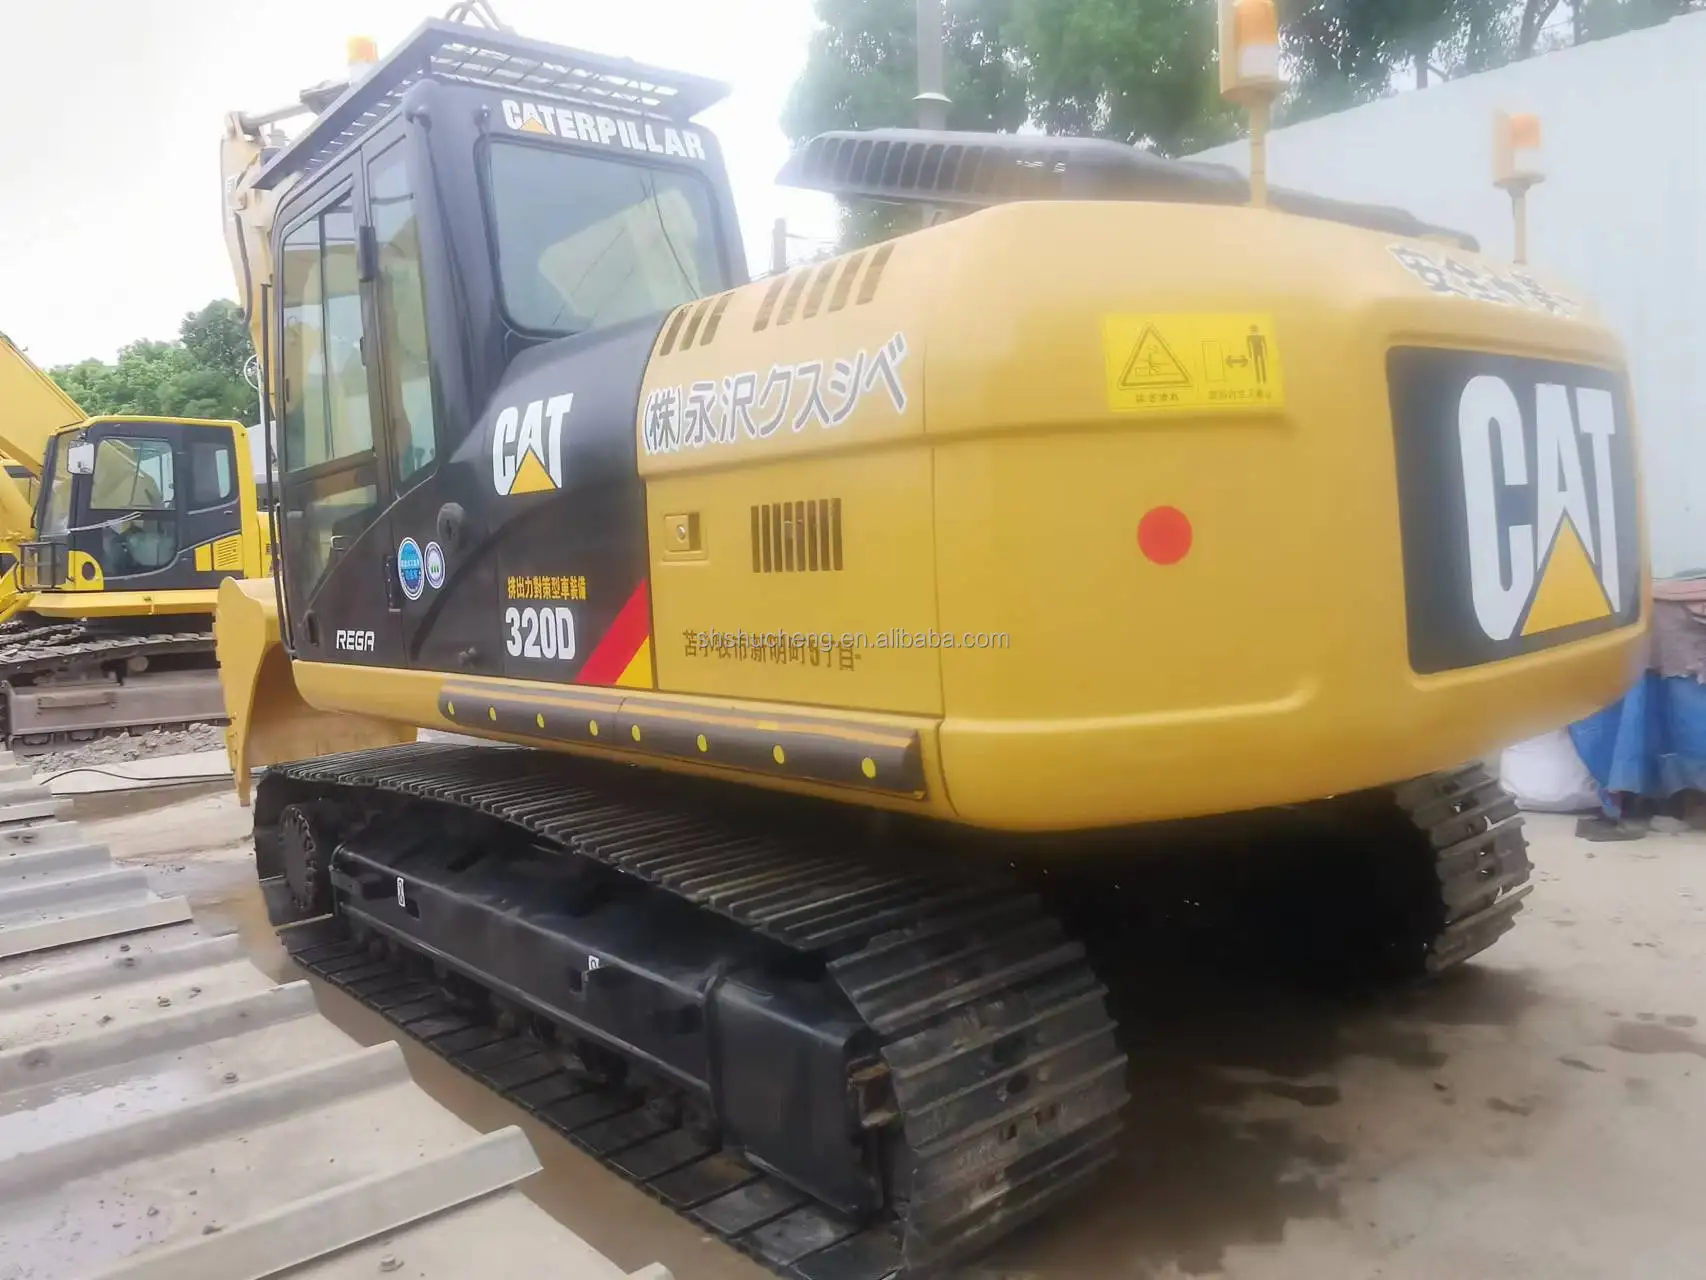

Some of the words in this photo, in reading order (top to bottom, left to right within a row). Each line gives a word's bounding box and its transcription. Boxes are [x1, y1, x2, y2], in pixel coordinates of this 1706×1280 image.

[501, 99, 706, 160] CATERPILLAR
[492, 392, 574, 496] CAT
[1458, 374, 1621, 641] CAT
[336, 629, 375, 652] REGA
[505, 607, 576, 660] 320D
